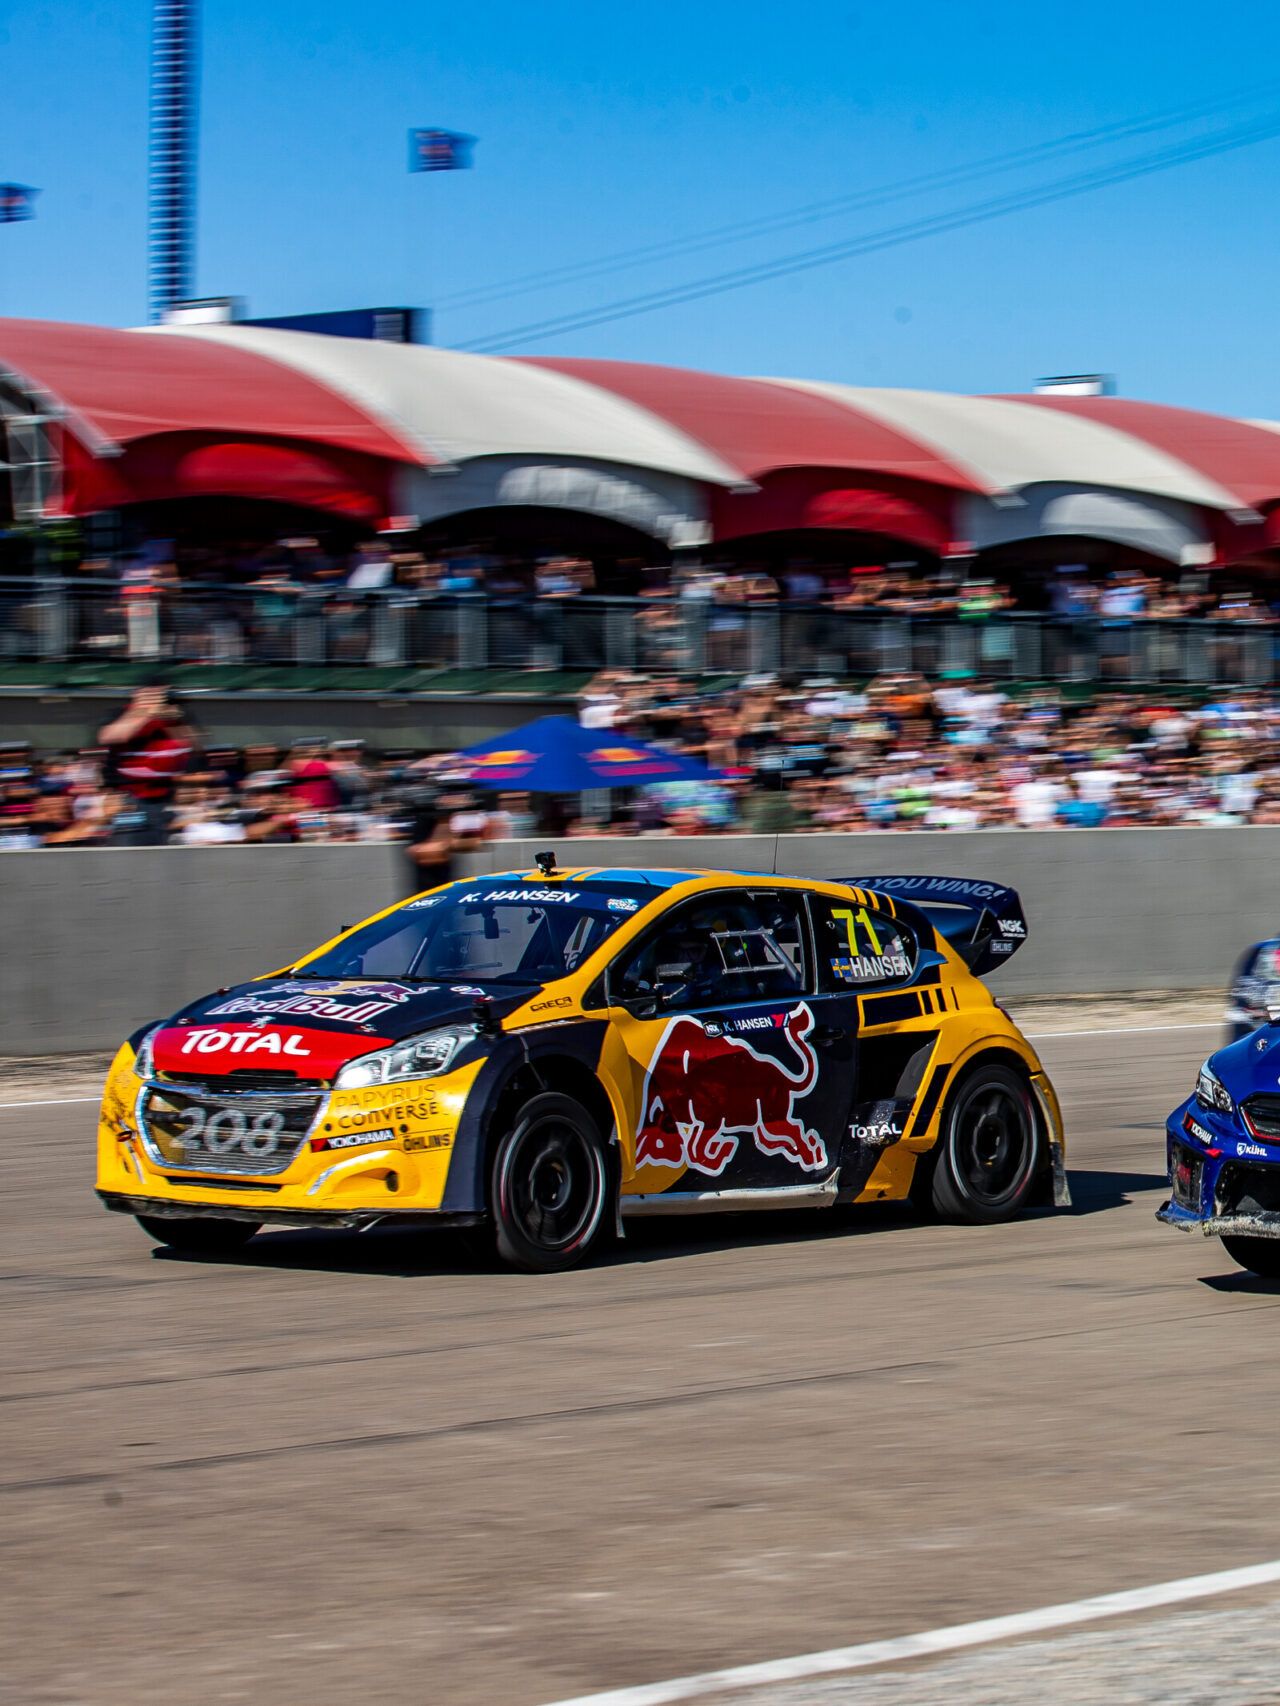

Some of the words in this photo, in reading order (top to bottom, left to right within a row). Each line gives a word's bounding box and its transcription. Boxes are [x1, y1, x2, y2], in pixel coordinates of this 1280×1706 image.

[870, 878, 924, 890] YOU
[458, 893, 478, 904] K.
[484, 890, 581, 904] HANSEN
[831, 907, 883, 956] 71
[997, 919, 1025, 933] NGK
[850, 956, 914, 977] HANSEN
[723, 1021, 735, 1032] K.
[734, 1016, 773, 1031] HANSEN
[181, 1028, 311, 1056] TOTAL
[169, 1106, 285, 1157] 208
[327, 1129, 396, 1149] YOKOHAMA
[848, 1122, 902, 1139] TOTAL
